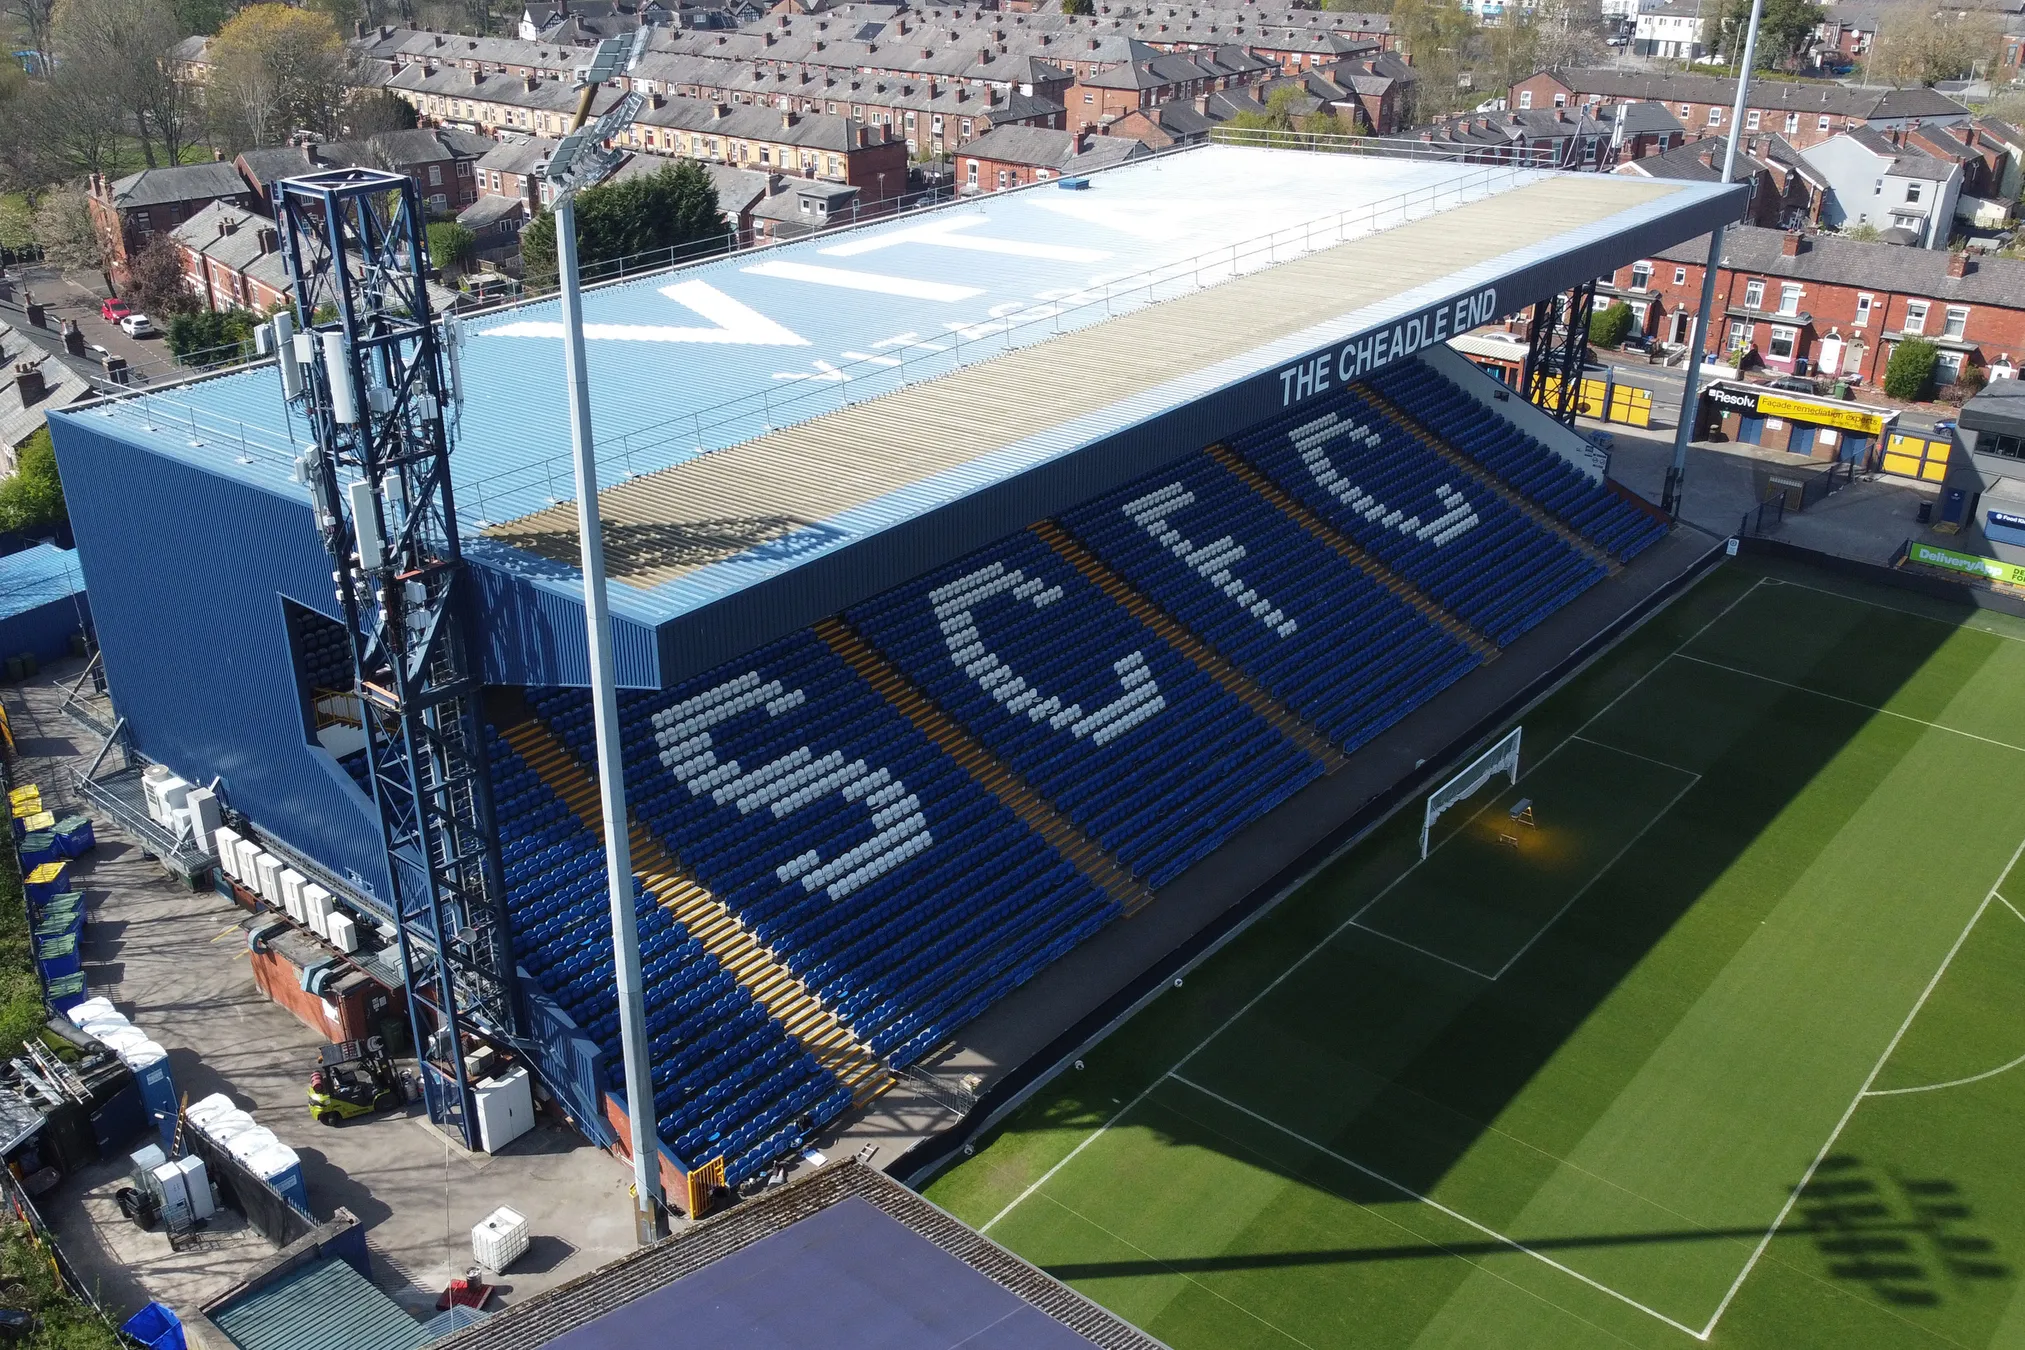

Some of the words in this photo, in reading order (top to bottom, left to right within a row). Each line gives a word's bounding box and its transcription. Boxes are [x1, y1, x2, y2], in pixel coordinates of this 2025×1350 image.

[1280, 353, 1332, 407] THE
[1338, 306, 1450, 382] CHEADLE
[1452, 287, 1497, 335] END
[1761, 397, 1792, 411] Façade
[1793, 404, 1844, 420] remediation
[2002, 514, 2018, 523] Food
[1918, 547, 2003, 577] DeliveryApp
